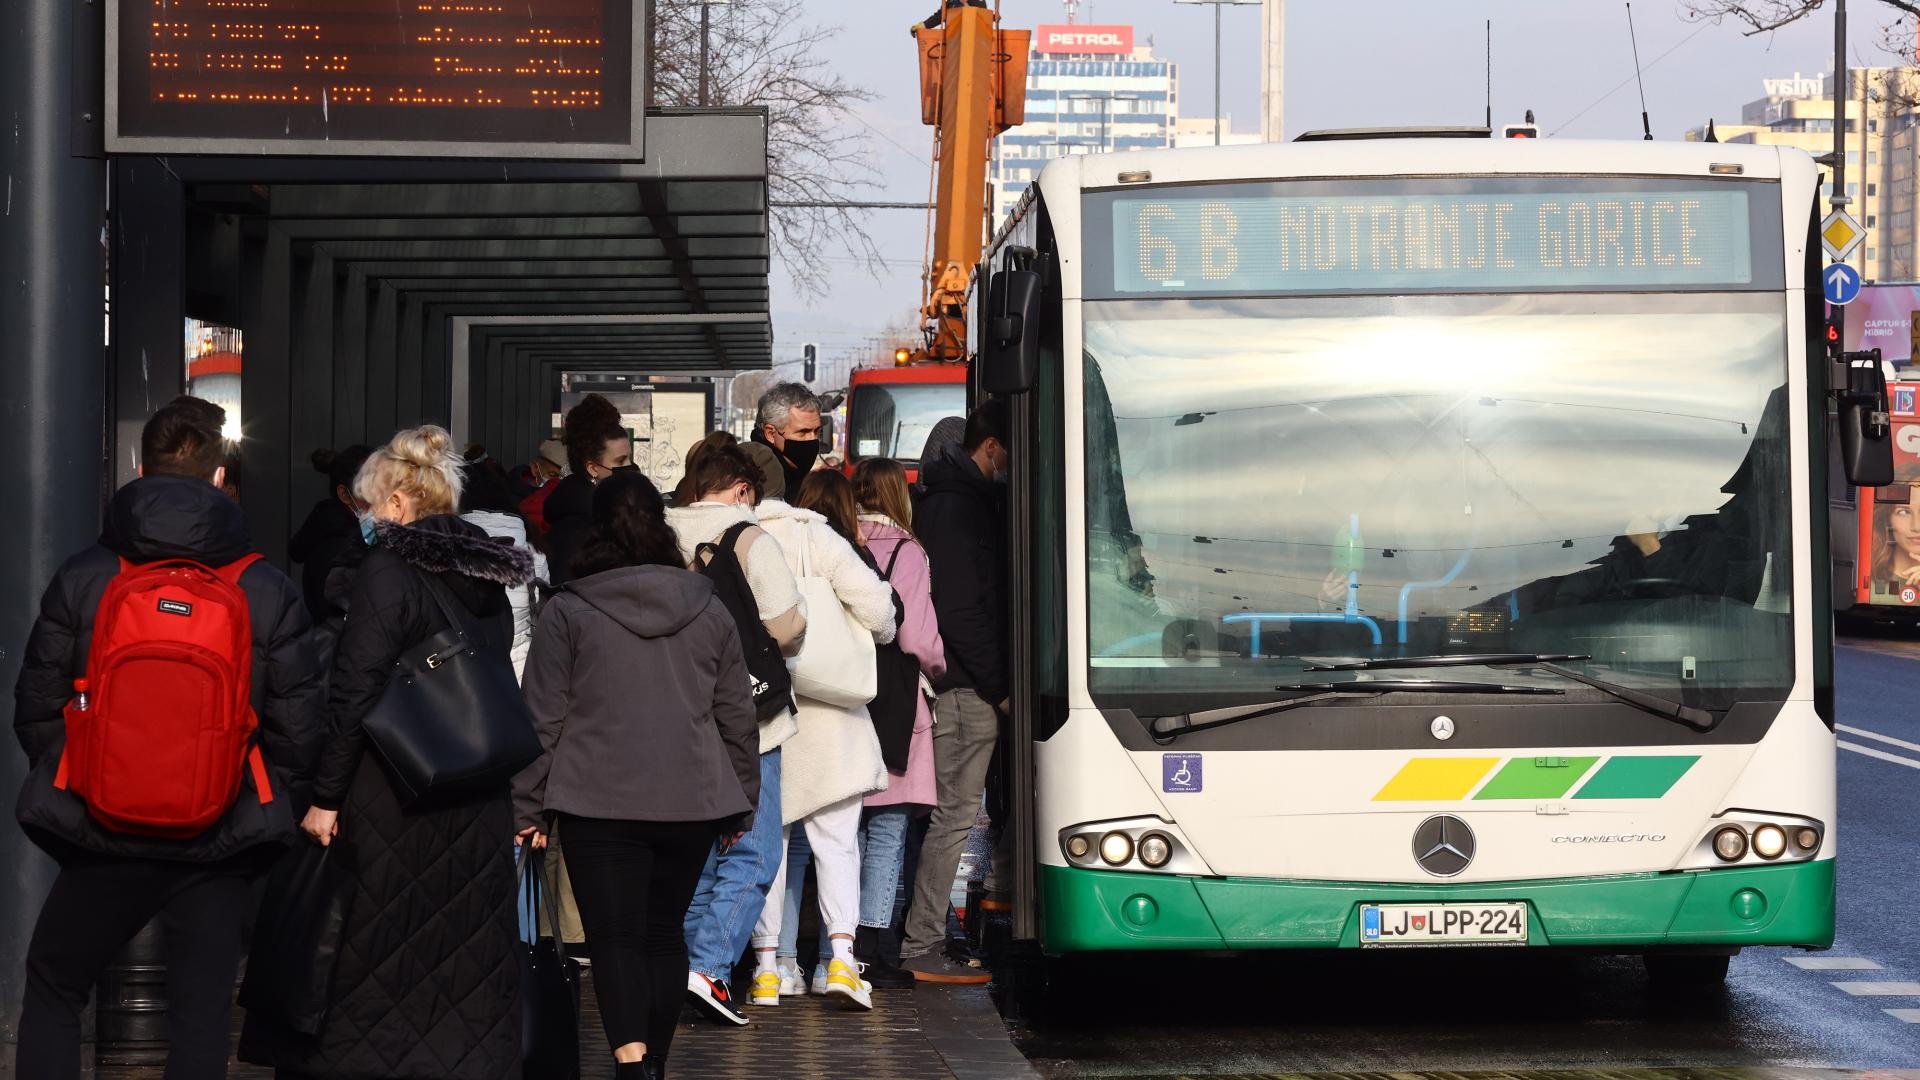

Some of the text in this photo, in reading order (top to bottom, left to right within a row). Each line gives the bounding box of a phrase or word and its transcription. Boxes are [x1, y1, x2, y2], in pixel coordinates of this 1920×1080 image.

[1048, 33, 1123, 45] PETROL
[1139, 201, 1701, 280] 6 B NOTRANJE GORICE
[1904, 591, 1913, 600] 50
[1551, 834, 1666, 843] CONECTO
[1380, 910, 1521, 935] LJ LPP-224
[1366, 928, 1377, 936] SLO
